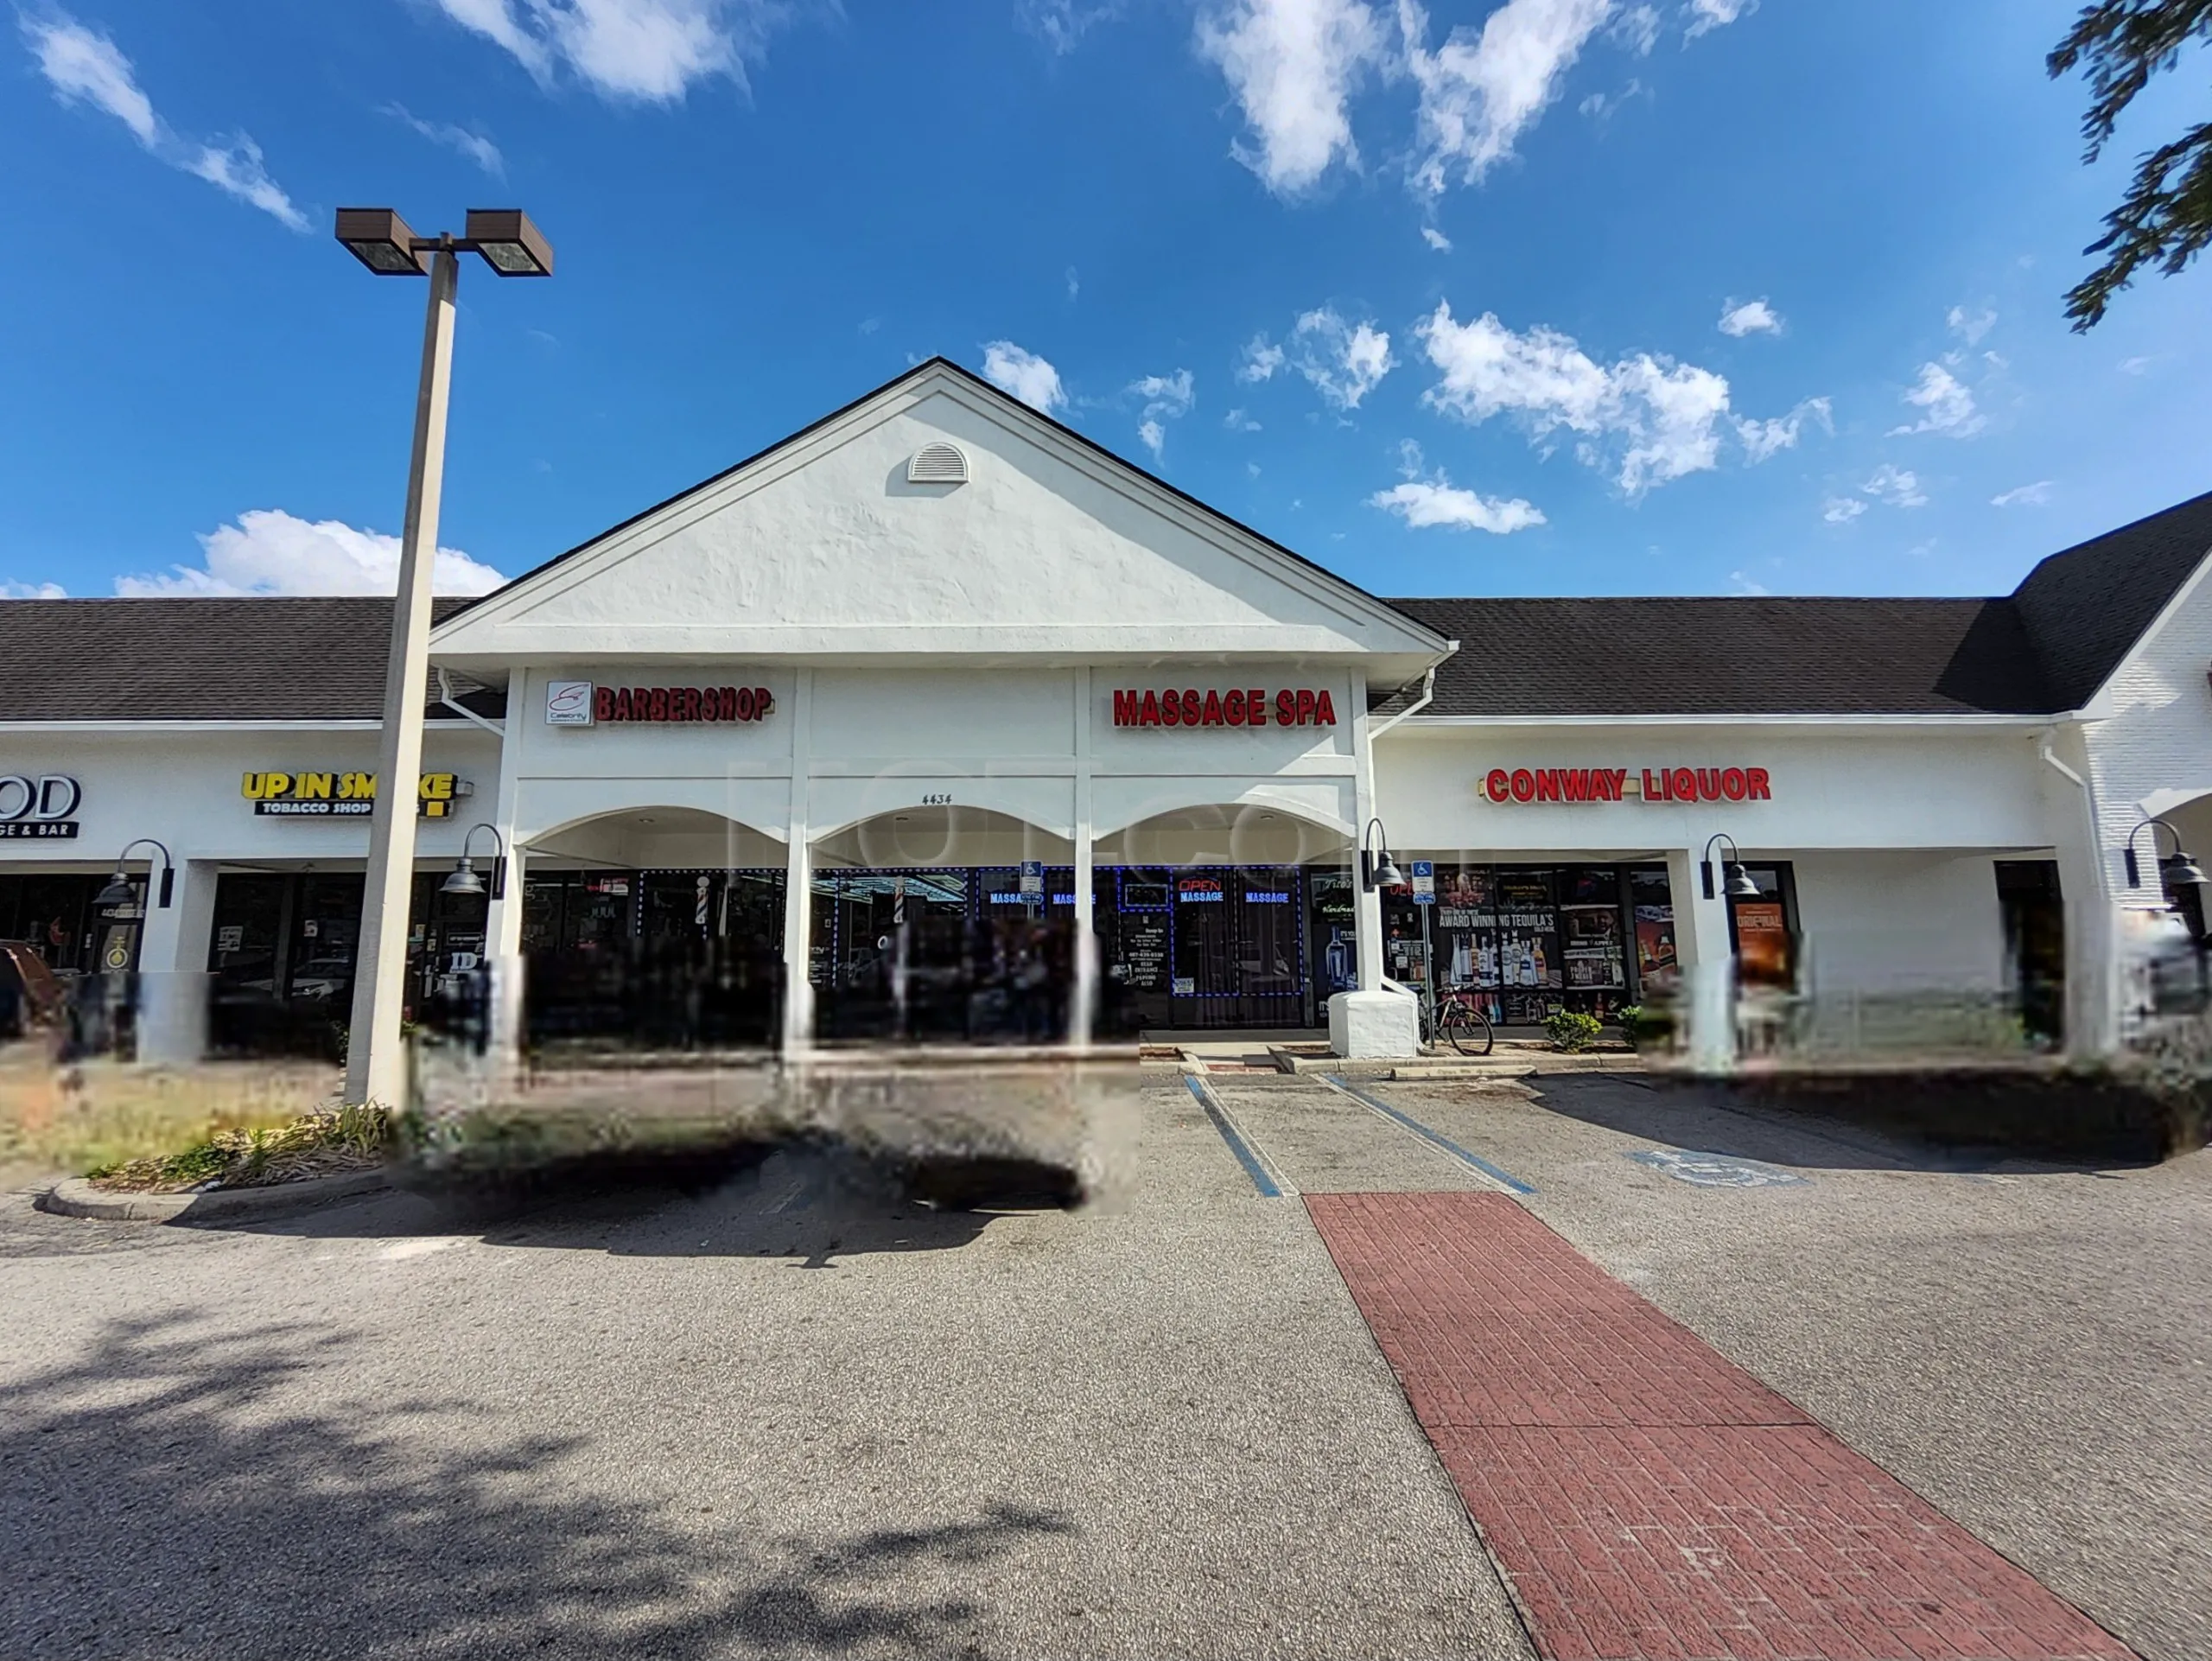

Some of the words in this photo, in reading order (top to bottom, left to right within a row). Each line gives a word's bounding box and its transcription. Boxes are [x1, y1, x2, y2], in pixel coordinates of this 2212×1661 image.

[594, 687, 772, 721] BARBERSHOP
[1113, 689, 1267, 726] MASSAGE
[1275, 689, 1336, 726] SPA
[241, 773, 292, 799] UP
[294, 773, 338, 799] IN
[338, 773, 458, 799] SMKE
[1484, 767, 1627, 803] CONWAY
[1641, 767, 1772, 803] LIQUOR
[922, 793, 952, 805] 4434
[263, 803, 329, 813] TOBACCO
[333, 803, 371, 813] SHOP
[22, 825, 31, 836] &
[39, 824, 68, 836] BAR
[1179, 880, 1222, 892] OPEN
[990, 893, 1022, 904] MASSA
[1180, 891, 1224, 903] MASSAGE
[1245, 892, 1289, 903] MASSAGE
[1439, 914, 1470, 927] AWARD
[1471, 914, 1510, 927] WINNING
[1512, 913, 1554, 926] TEQUILA'S
[451, 952, 478, 971] ID
